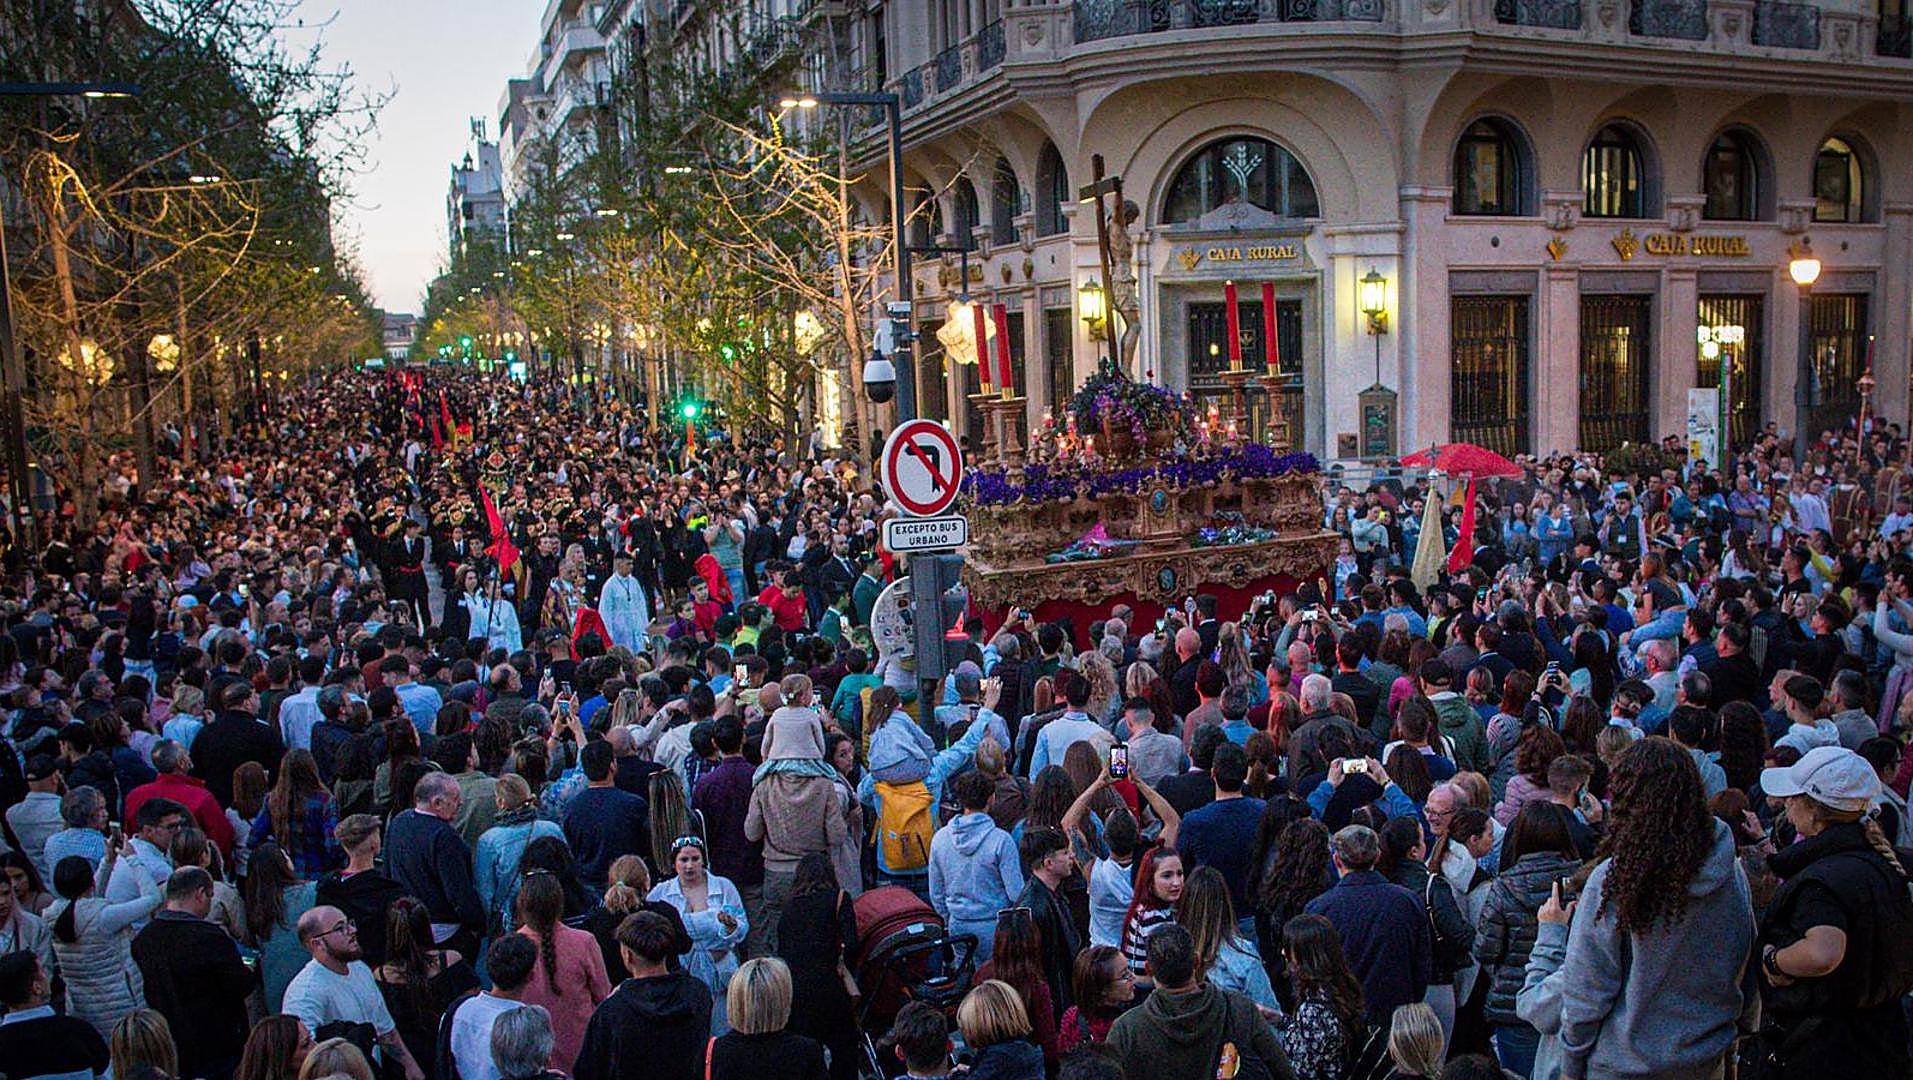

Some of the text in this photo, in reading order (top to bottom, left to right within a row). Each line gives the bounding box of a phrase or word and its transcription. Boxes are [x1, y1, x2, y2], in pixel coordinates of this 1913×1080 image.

[1207, 245, 1297, 261] CAJA RURAL
[1691, 236, 1751, 256] RURAL
[895, 523, 958, 535] EXCEPTO BUS
[909, 535, 948, 545] URBANO
